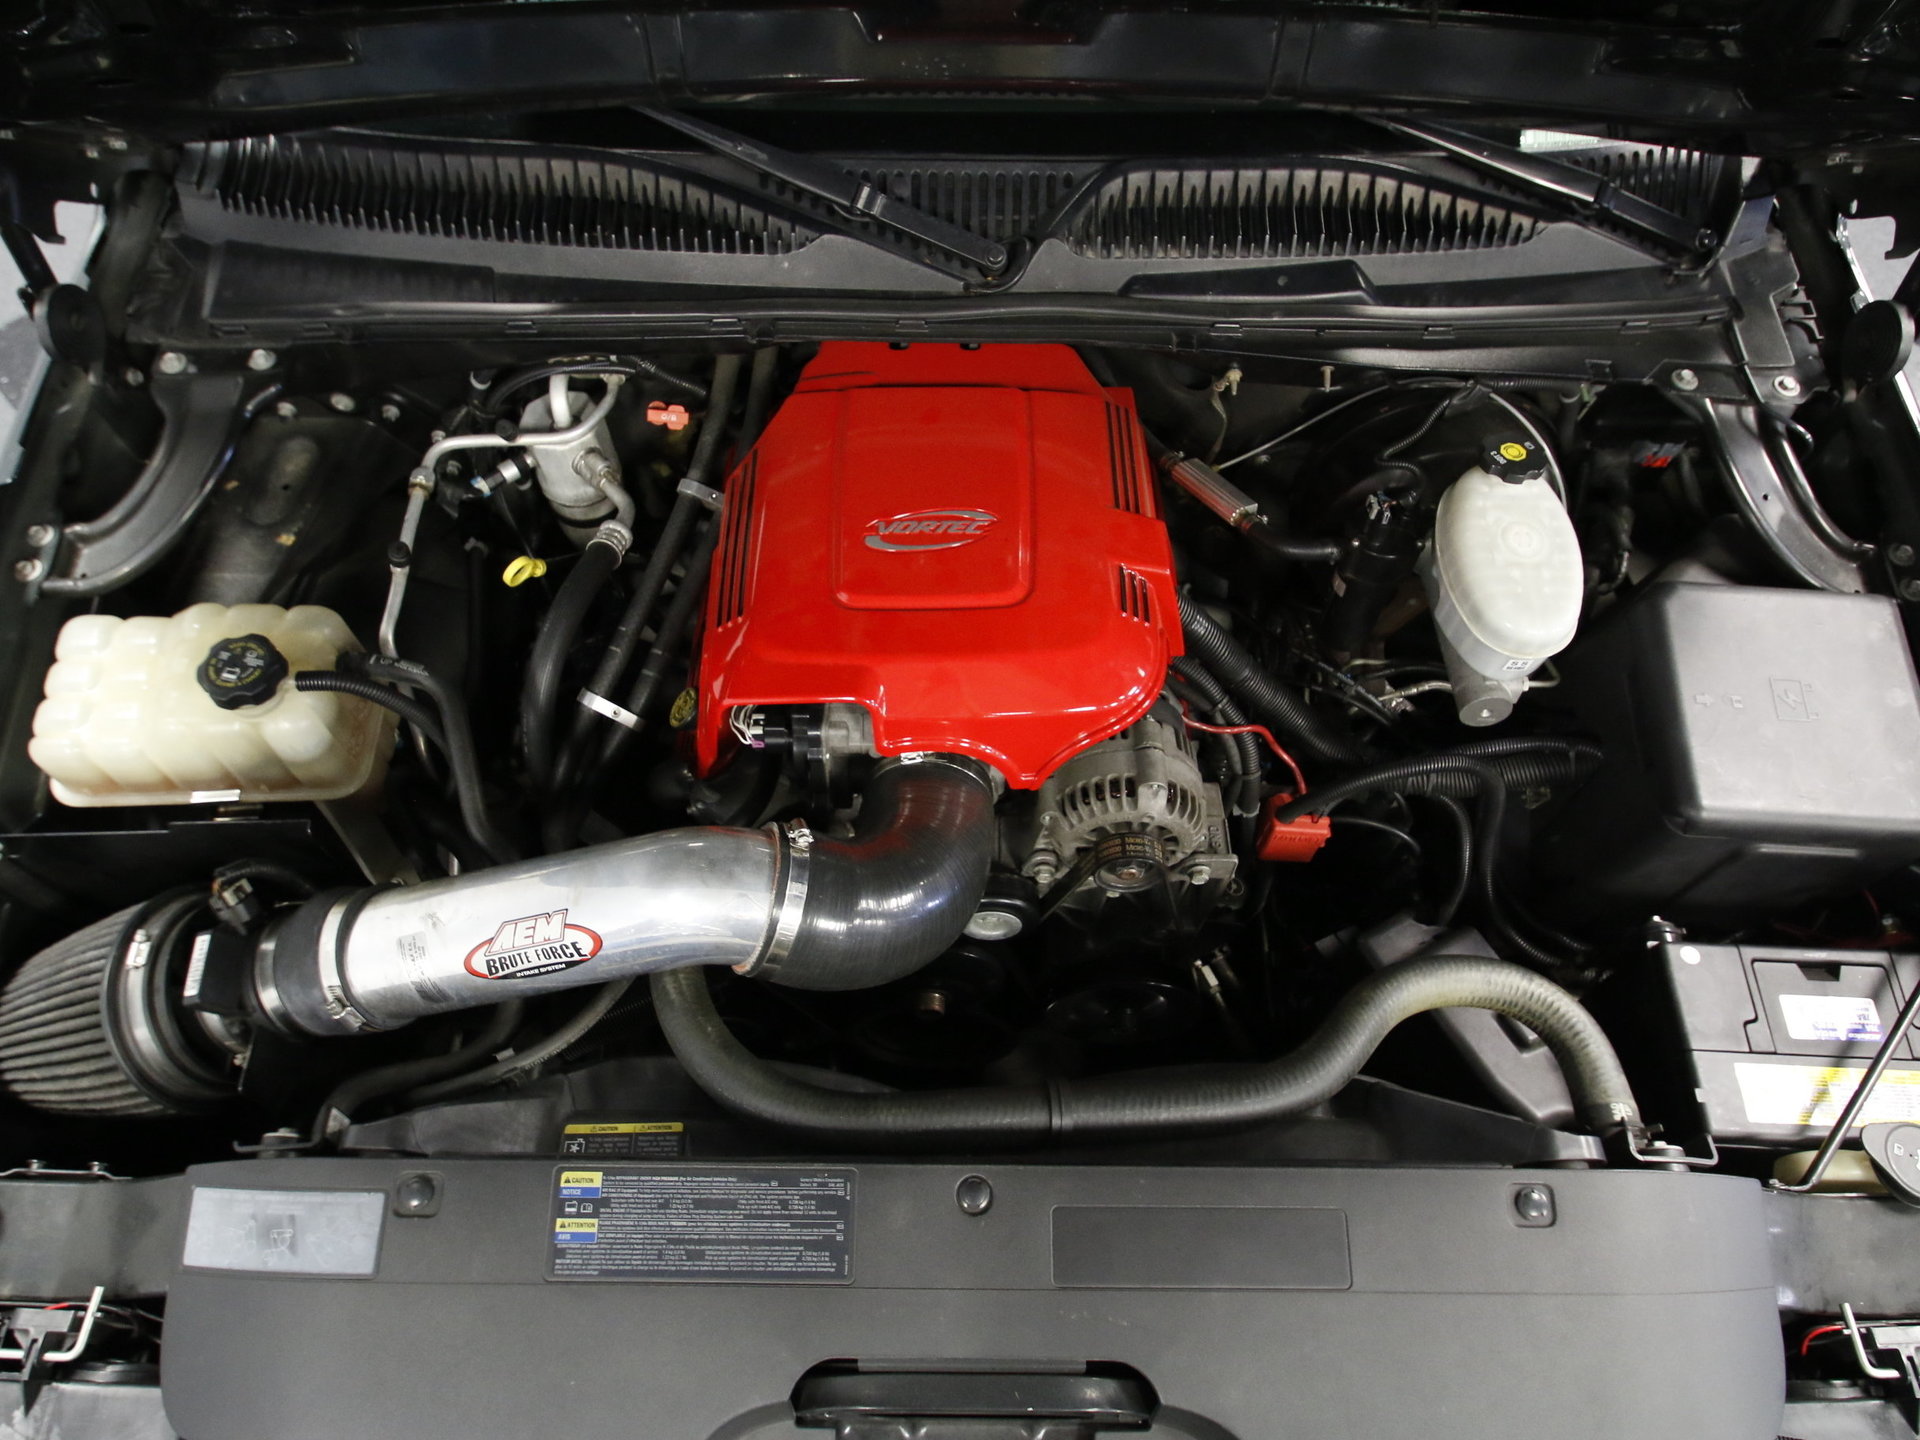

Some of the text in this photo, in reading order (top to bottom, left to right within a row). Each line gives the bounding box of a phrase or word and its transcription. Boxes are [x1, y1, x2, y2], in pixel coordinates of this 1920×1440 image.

[875, 519, 992, 535] VORTEC
[486, 910, 568, 955] AEM
[485, 941, 588, 977] BRUTE FORCE
[516, 962, 567, 977] INTAKE SYSTEM
